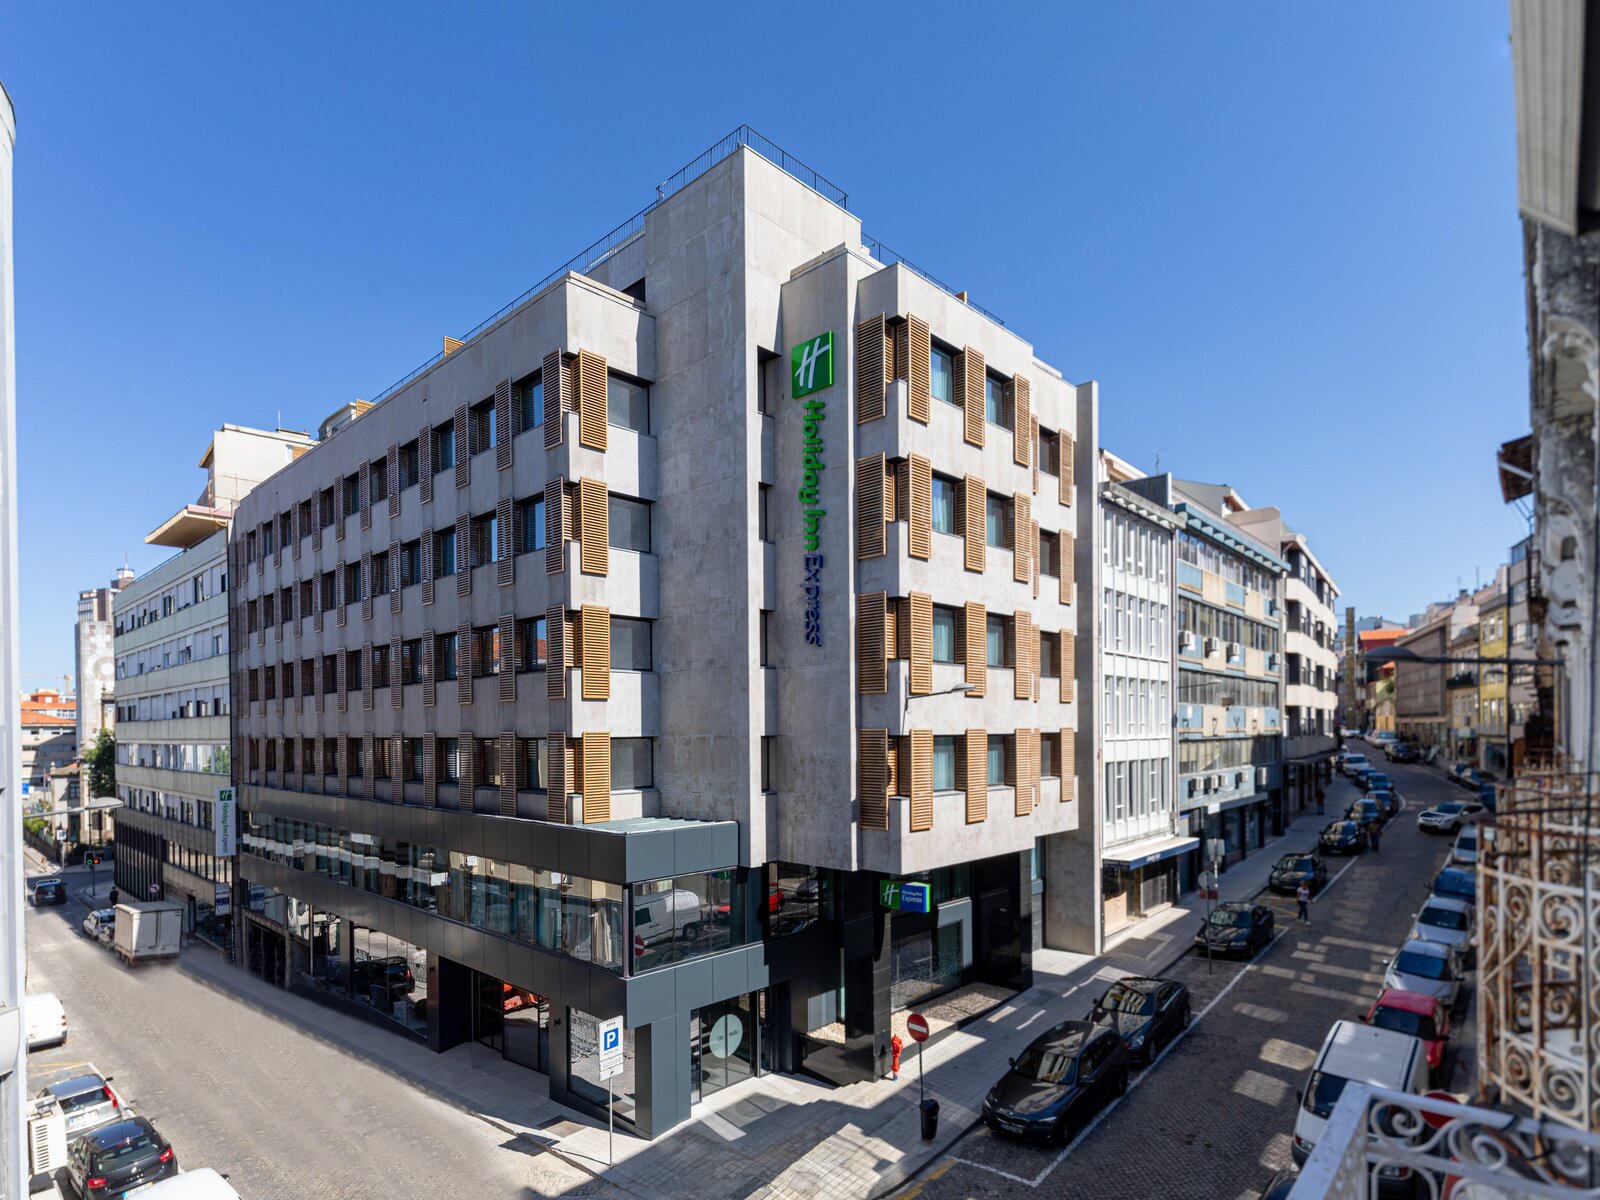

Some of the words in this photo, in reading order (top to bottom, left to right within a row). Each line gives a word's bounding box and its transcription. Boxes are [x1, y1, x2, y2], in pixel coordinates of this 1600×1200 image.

[798, 400, 827, 504] Holiday
[803, 509, 827, 551] Inn
[800, 554, 824, 647] Express
[901, 894, 923, 903] Express
[606, 1031, 616, 1049] P
